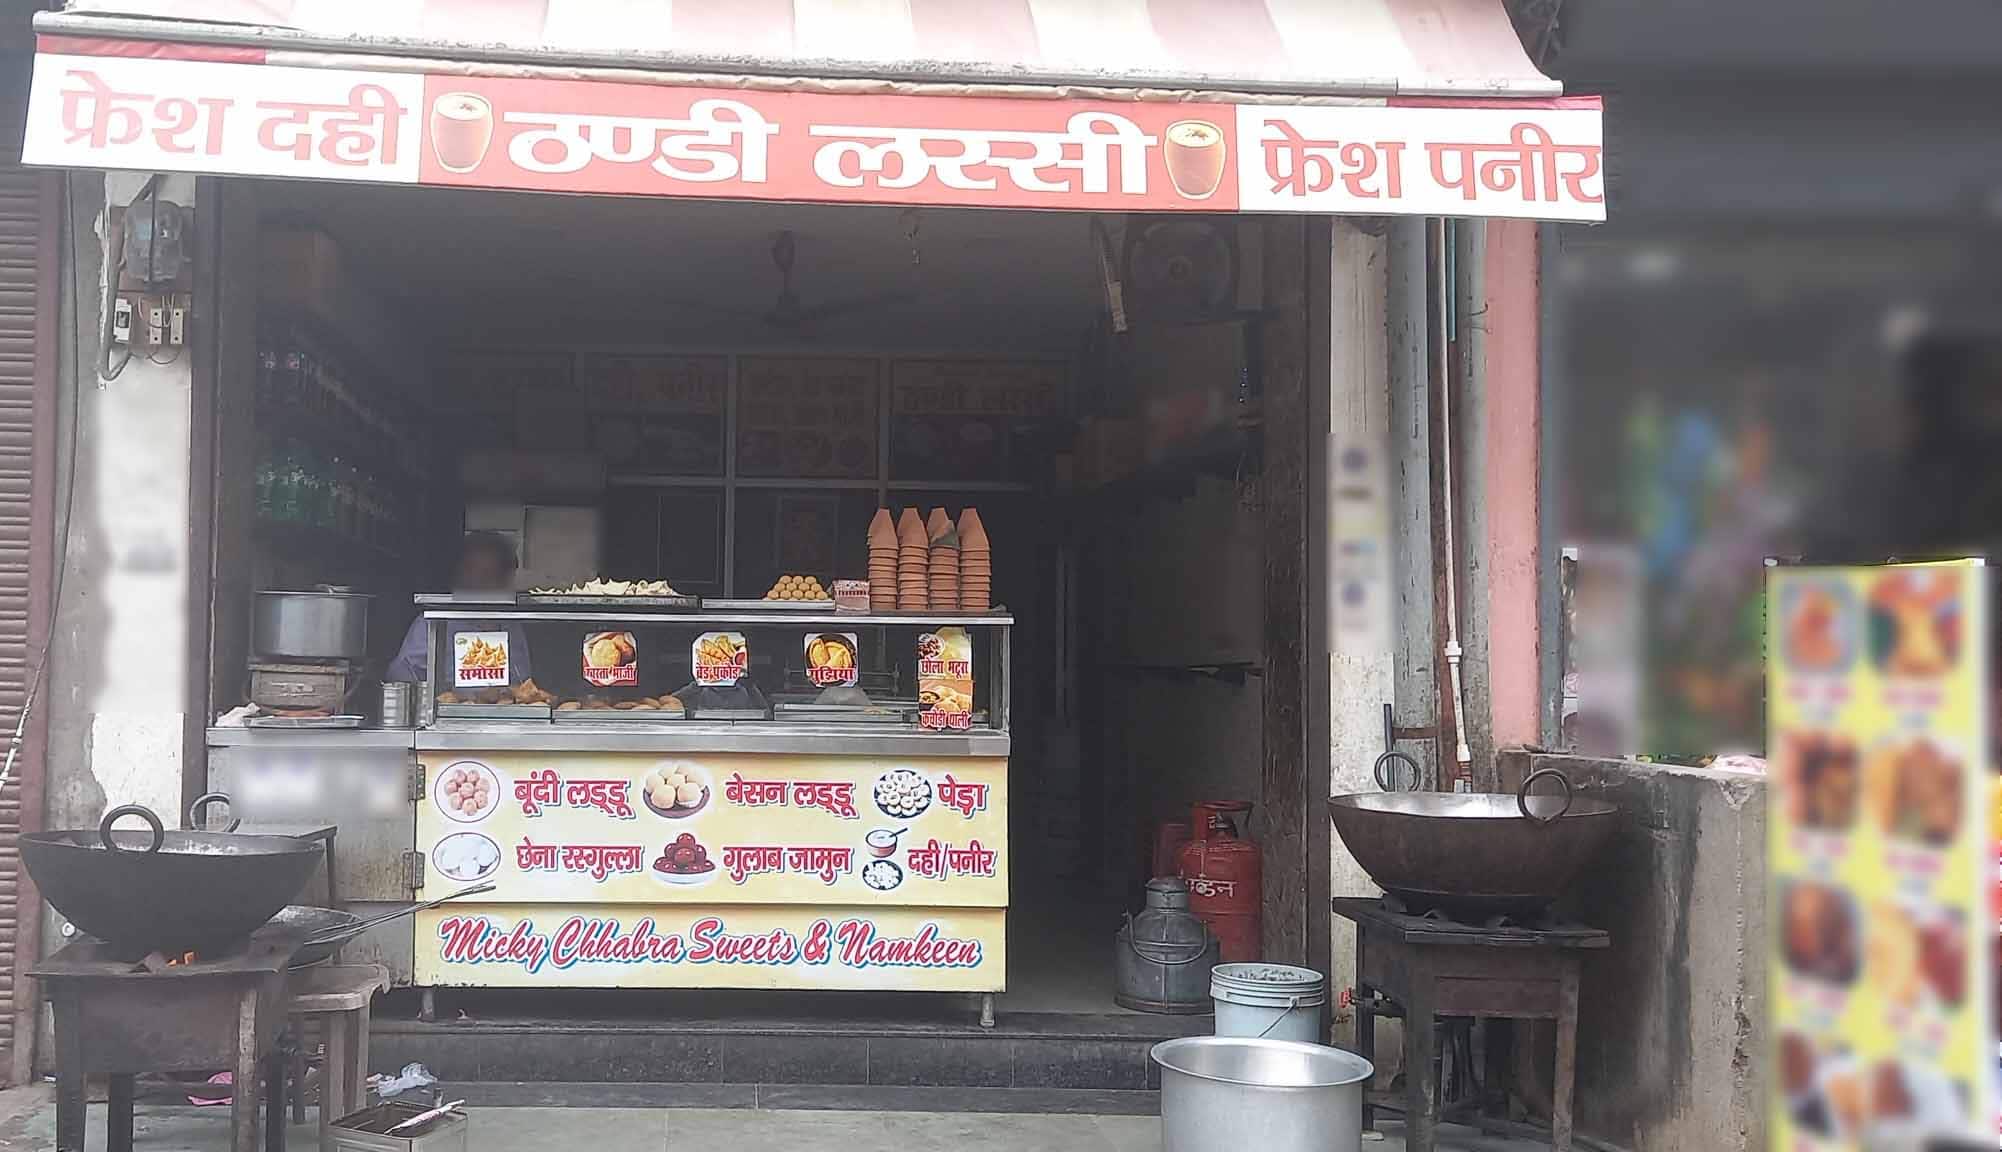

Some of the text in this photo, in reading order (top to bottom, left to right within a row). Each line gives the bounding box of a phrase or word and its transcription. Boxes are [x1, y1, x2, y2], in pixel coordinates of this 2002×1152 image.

[60, 70, 408, 166] फ्रेश दही
[503, 98, 1158, 195] ठण्डी लस्सी
[1261, 120, 1602, 203] फ्रेश पनीर
[458, 665, 505, 681] समोसा
[724, 772, 788, 807] बेसन
[516, 836, 557, 869] छेना
[723, 847, 851, 881] गुलाब जामुन
[441, 918, 977, 971] Micky Chhabra Sweets & Namkeen
